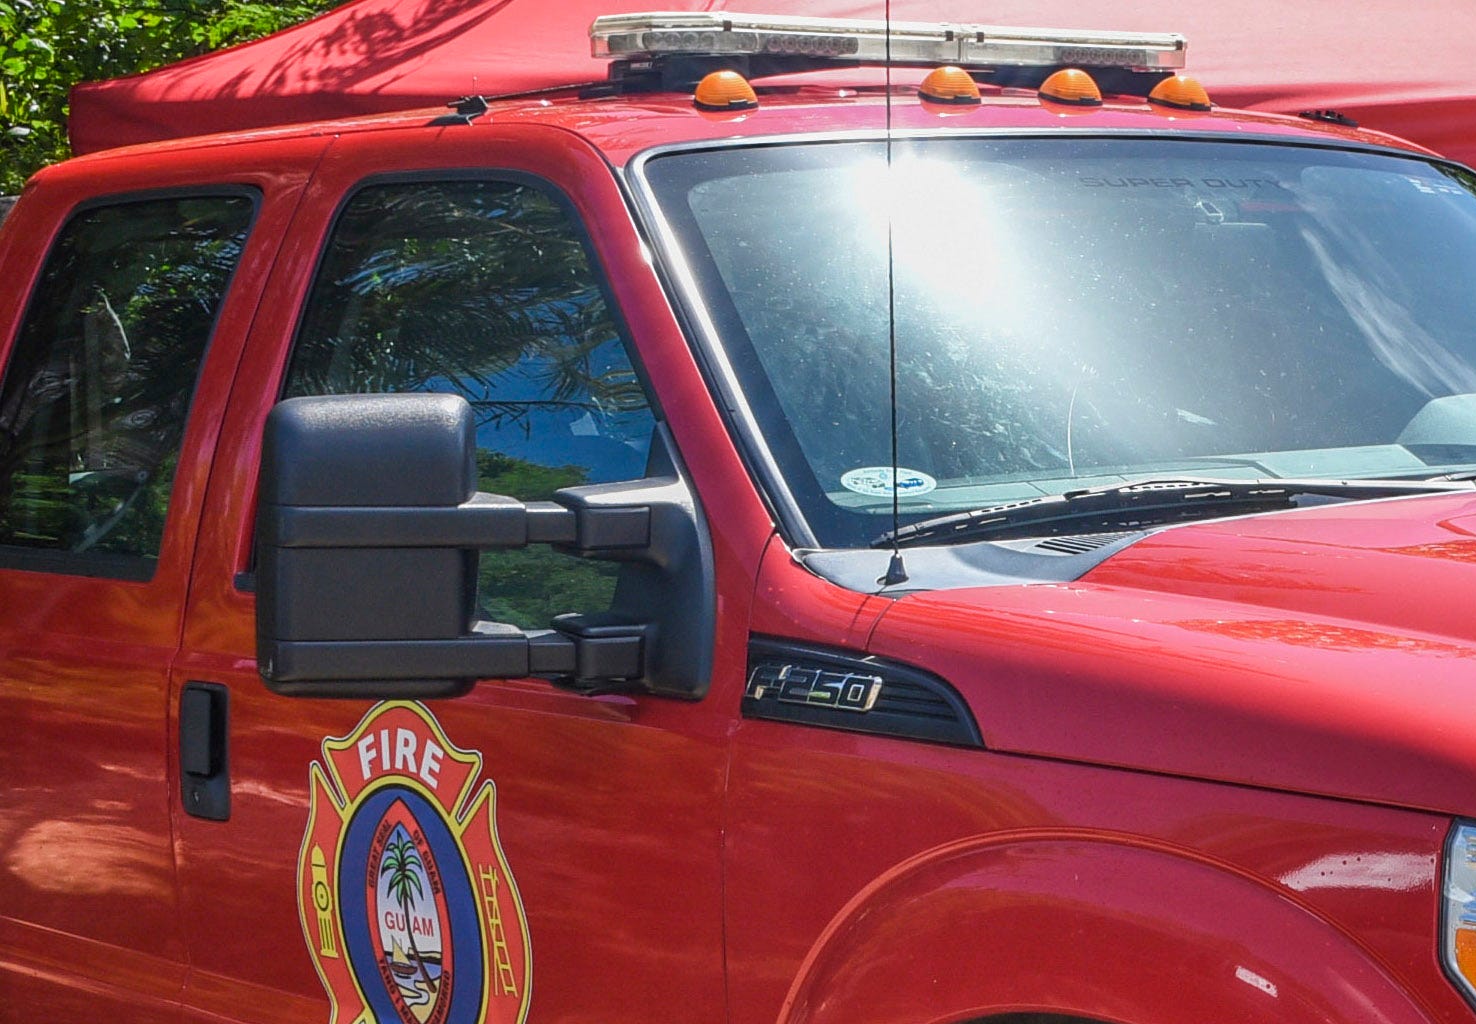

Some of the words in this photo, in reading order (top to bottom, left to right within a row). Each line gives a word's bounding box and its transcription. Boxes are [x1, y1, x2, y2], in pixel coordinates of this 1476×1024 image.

[1079, 176, 1195, 189] SUPER
[1203, 177, 1282, 189] DUTY
[357, 727, 444, 789] FIRE
[384, 910, 434, 938] GUAM
